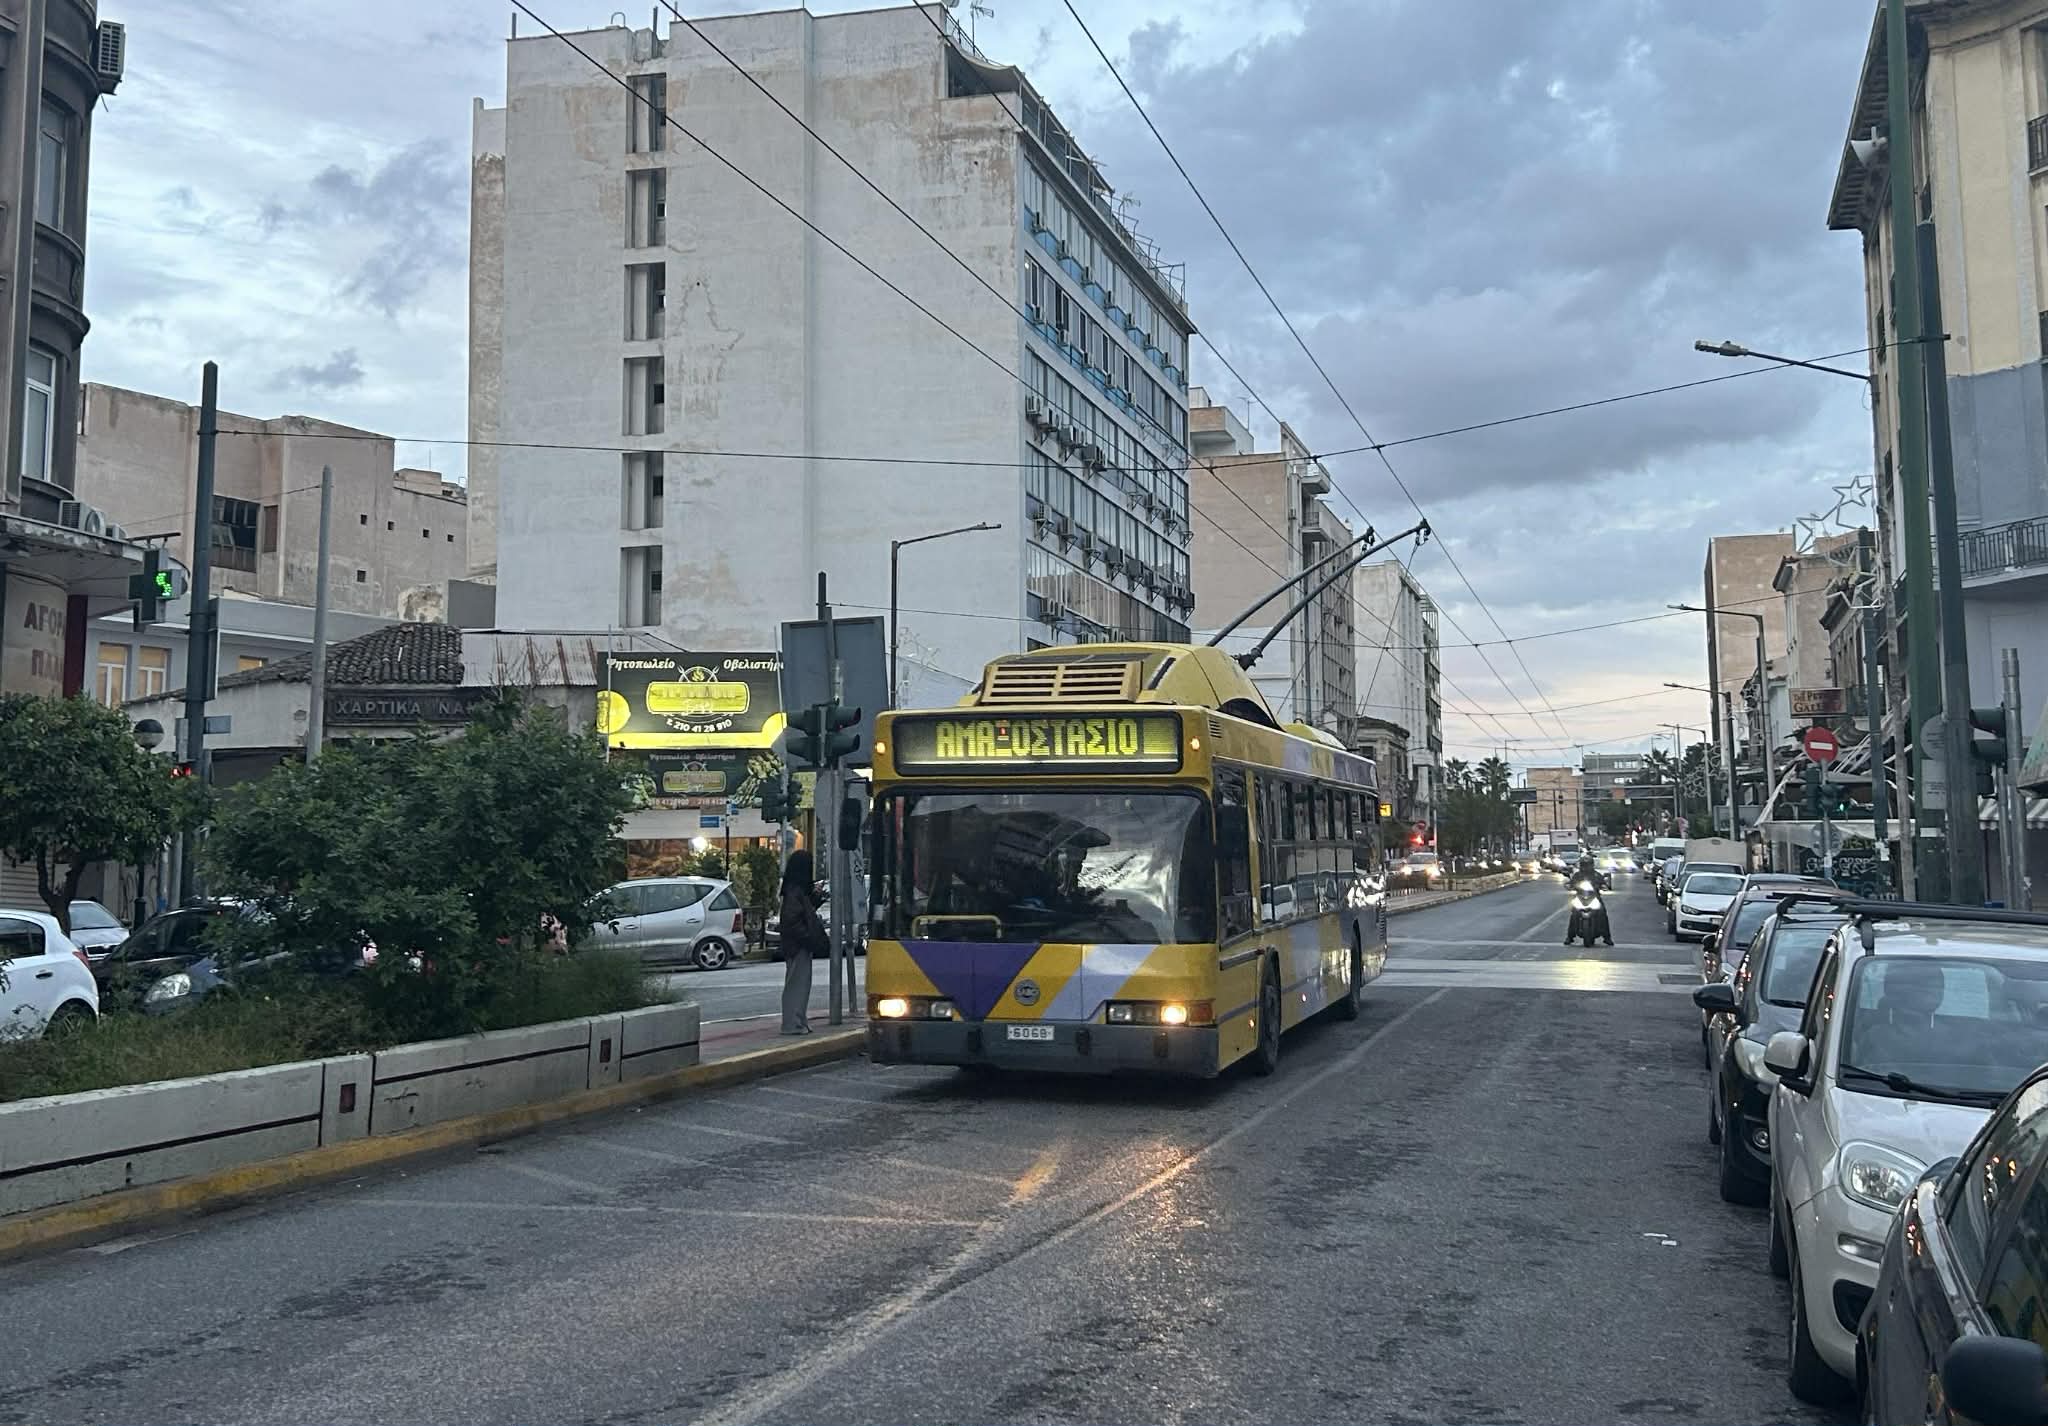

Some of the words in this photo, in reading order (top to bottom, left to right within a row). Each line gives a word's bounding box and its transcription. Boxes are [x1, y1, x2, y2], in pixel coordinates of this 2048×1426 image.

[336, 700, 421, 714] ΧΑΡΤΙΚΑ
[673, 722, 690, 731] 210
[691, 725, 702, 733] 41
[703, 725, 715, 733] 28
[936, 719, 1139, 758] ΑΜΑΞΟΣΤΑΣΙΟ
